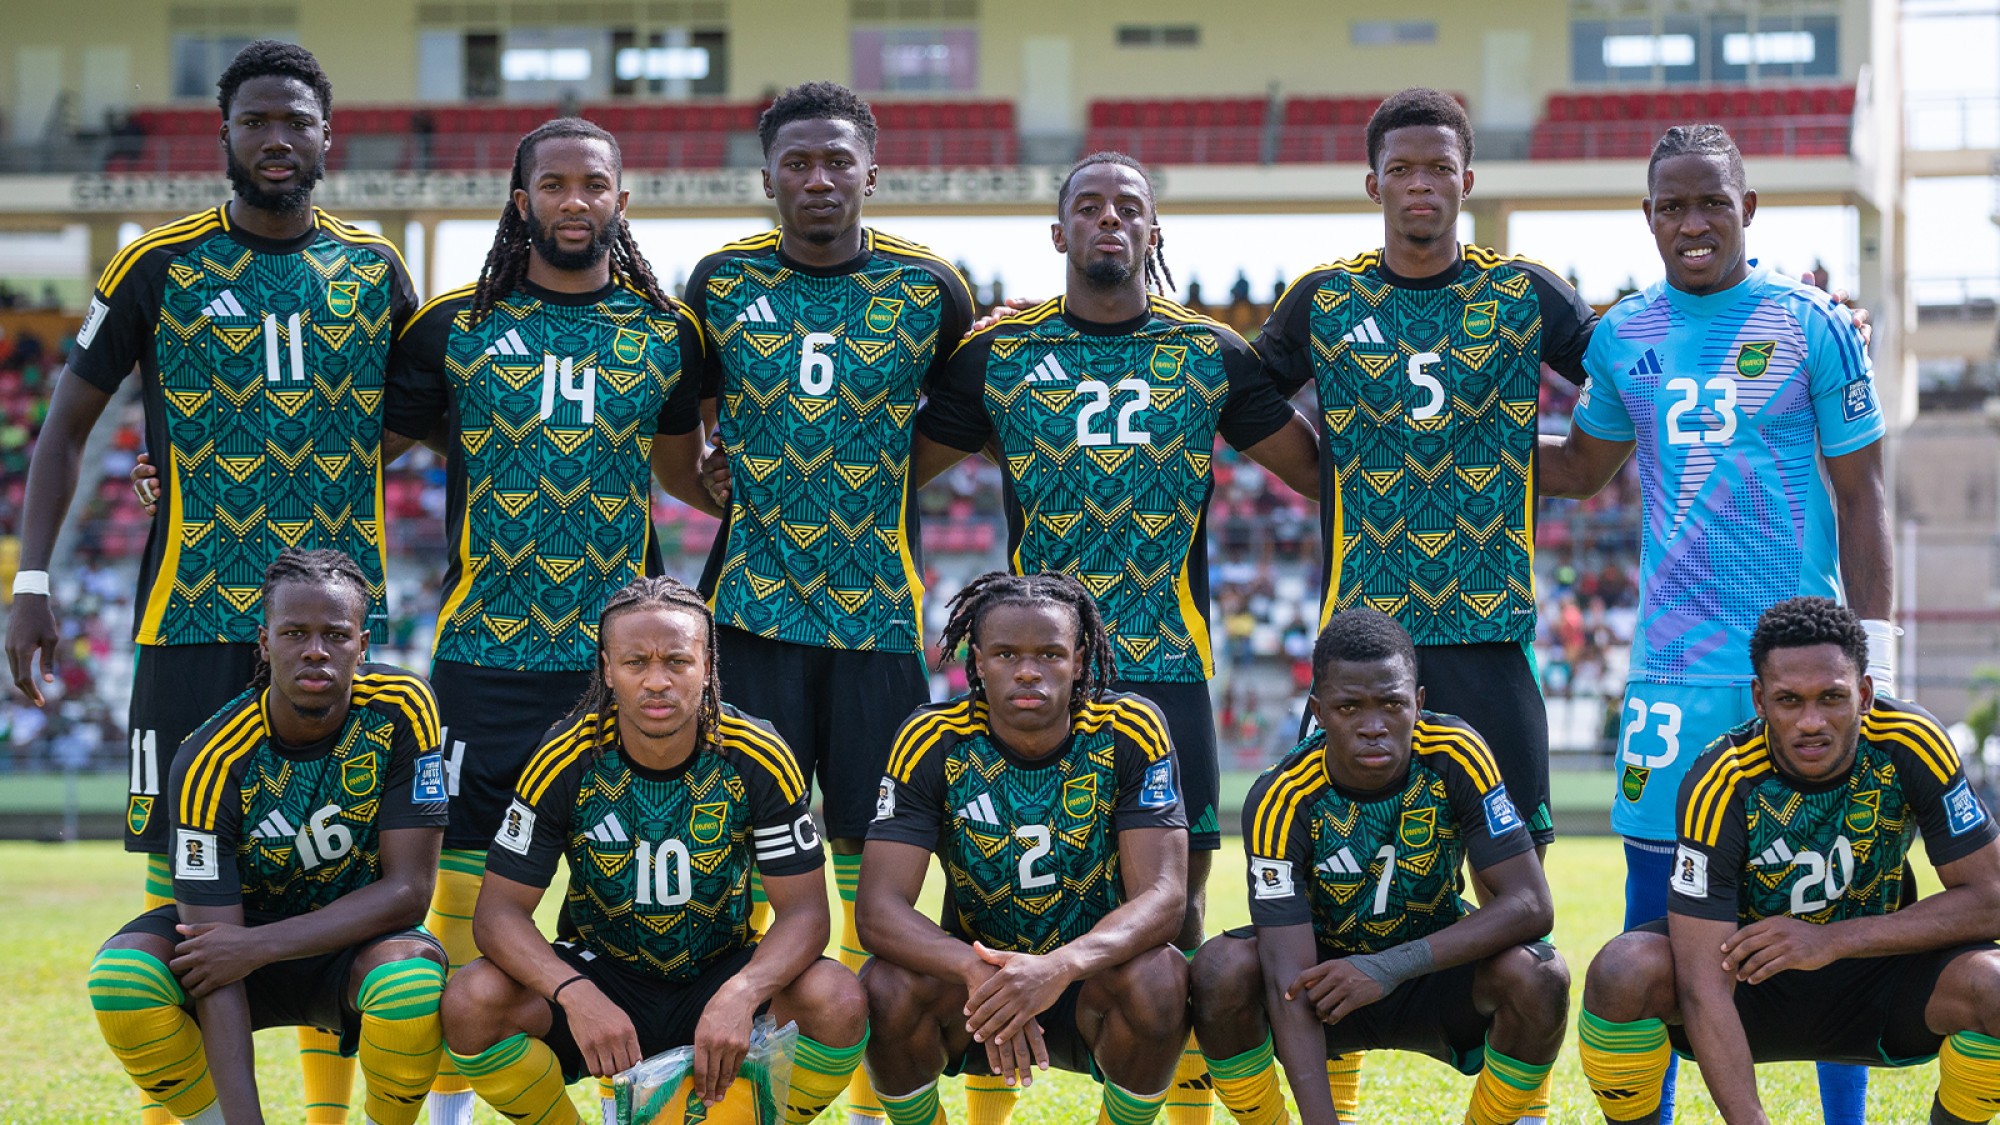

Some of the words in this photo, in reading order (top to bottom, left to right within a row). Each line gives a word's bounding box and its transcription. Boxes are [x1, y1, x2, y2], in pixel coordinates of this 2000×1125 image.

[264, 312, 304, 381] 11
[799, 332, 836, 396] 6
[539, 354, 596, 424] 14
[1076, 379, 1152, 447] 22
[1408, 352, 1446, 421] 5
[1666, 377, 1738, 446] 23
[130, 728, 160, 796] 11
[1622, 697, 1682, 768] 23
[296, 805, 352, 870] 16
[794, 813, 819, 851] C
[1015, 824, 1056, 889] 2
[634, 839, 692, 906] 10
[1790, 835, 1855, 915] 20
